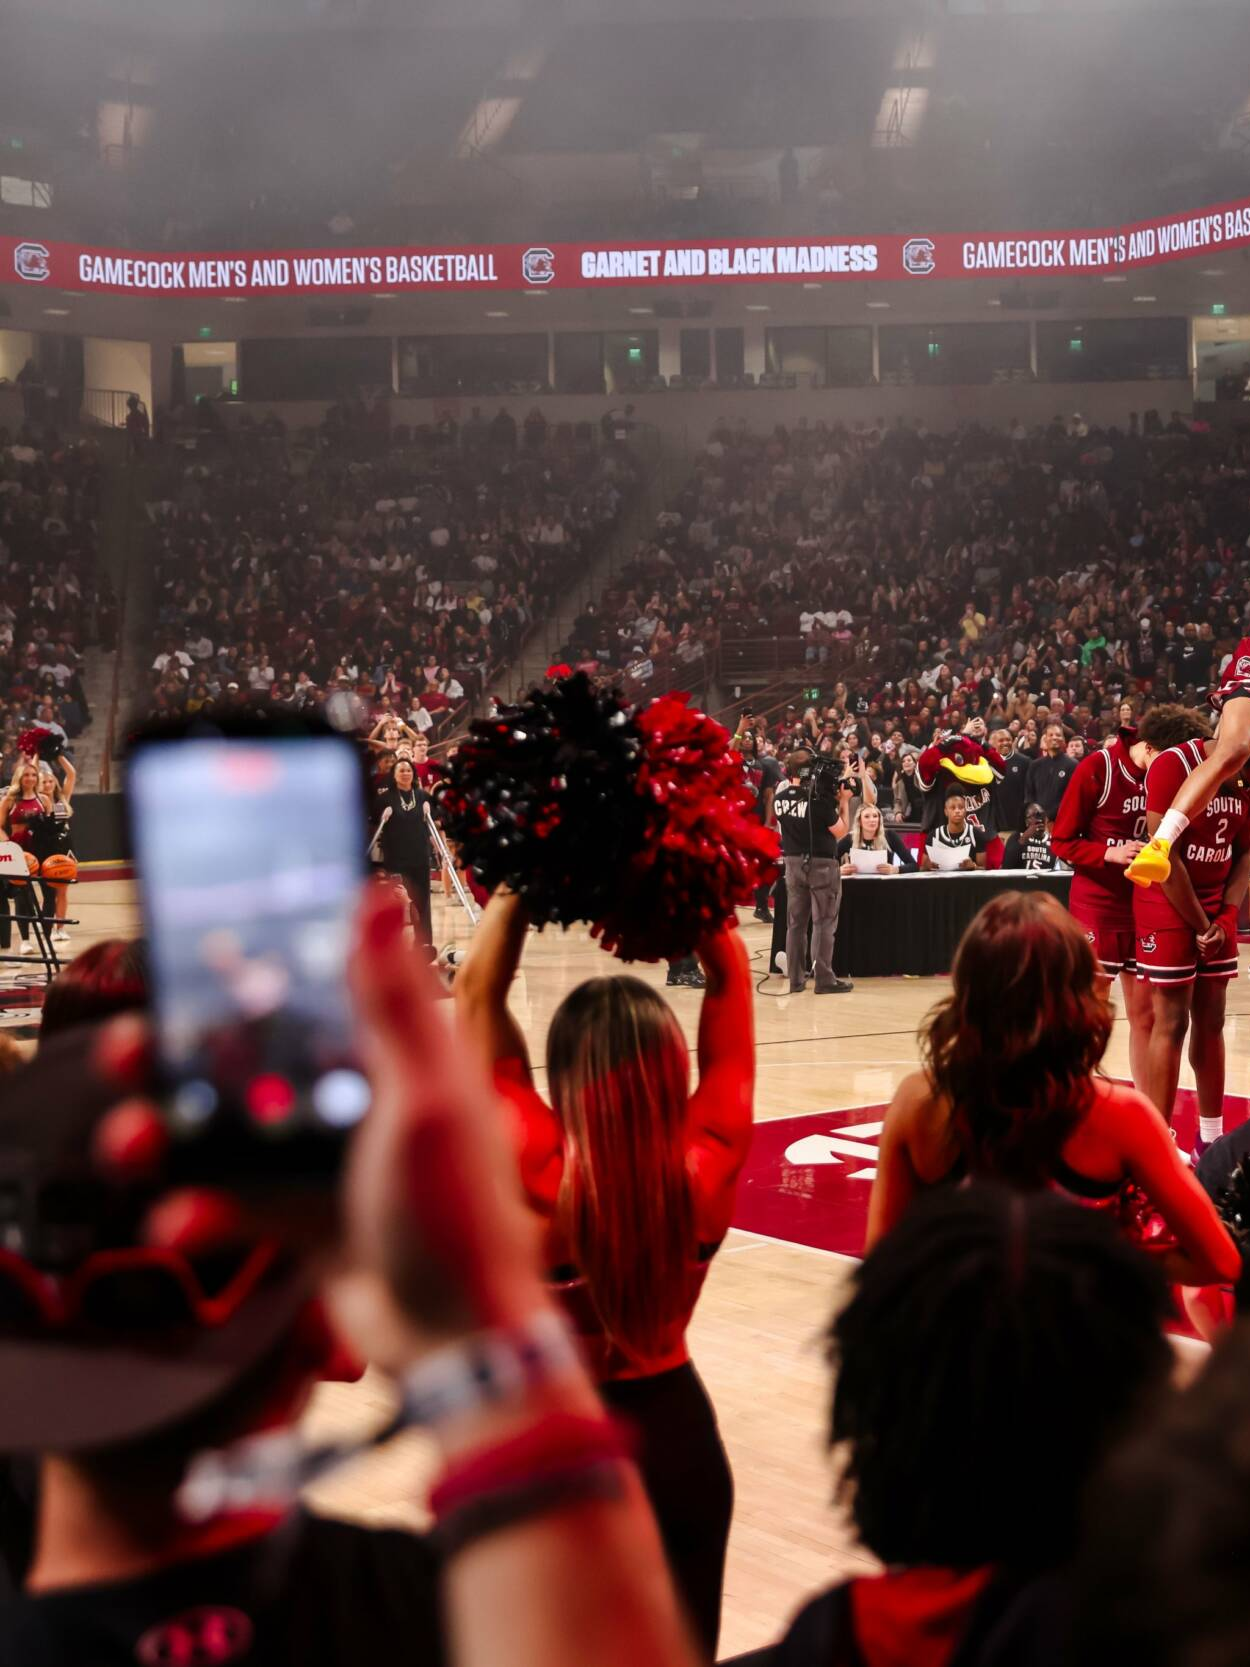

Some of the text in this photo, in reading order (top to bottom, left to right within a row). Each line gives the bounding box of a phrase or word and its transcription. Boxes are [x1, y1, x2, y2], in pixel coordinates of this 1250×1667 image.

[962, 240, 1066, 269] GAMECOCK
[1069, 236, 1126, 266] MEN'S
[1128, 228, 1155, 261] AND
[1157, 218, 1222, 254] WOMEN'S
[79, 254, 498, 289] GAMECOCK MEN'S AND WOMEN'S BASKETBALL
[581, 245, 878, 278] GARNET AND BLACK MADNESS
[774, 799, 808, 818] CREW
[1122, 796, 1147, 814] SOU
[1206, 796, 1242, 817] SOUTH
[1215, 818, 1228, 844] 2
[1021, 852, 1051, 862] CAROLINA
